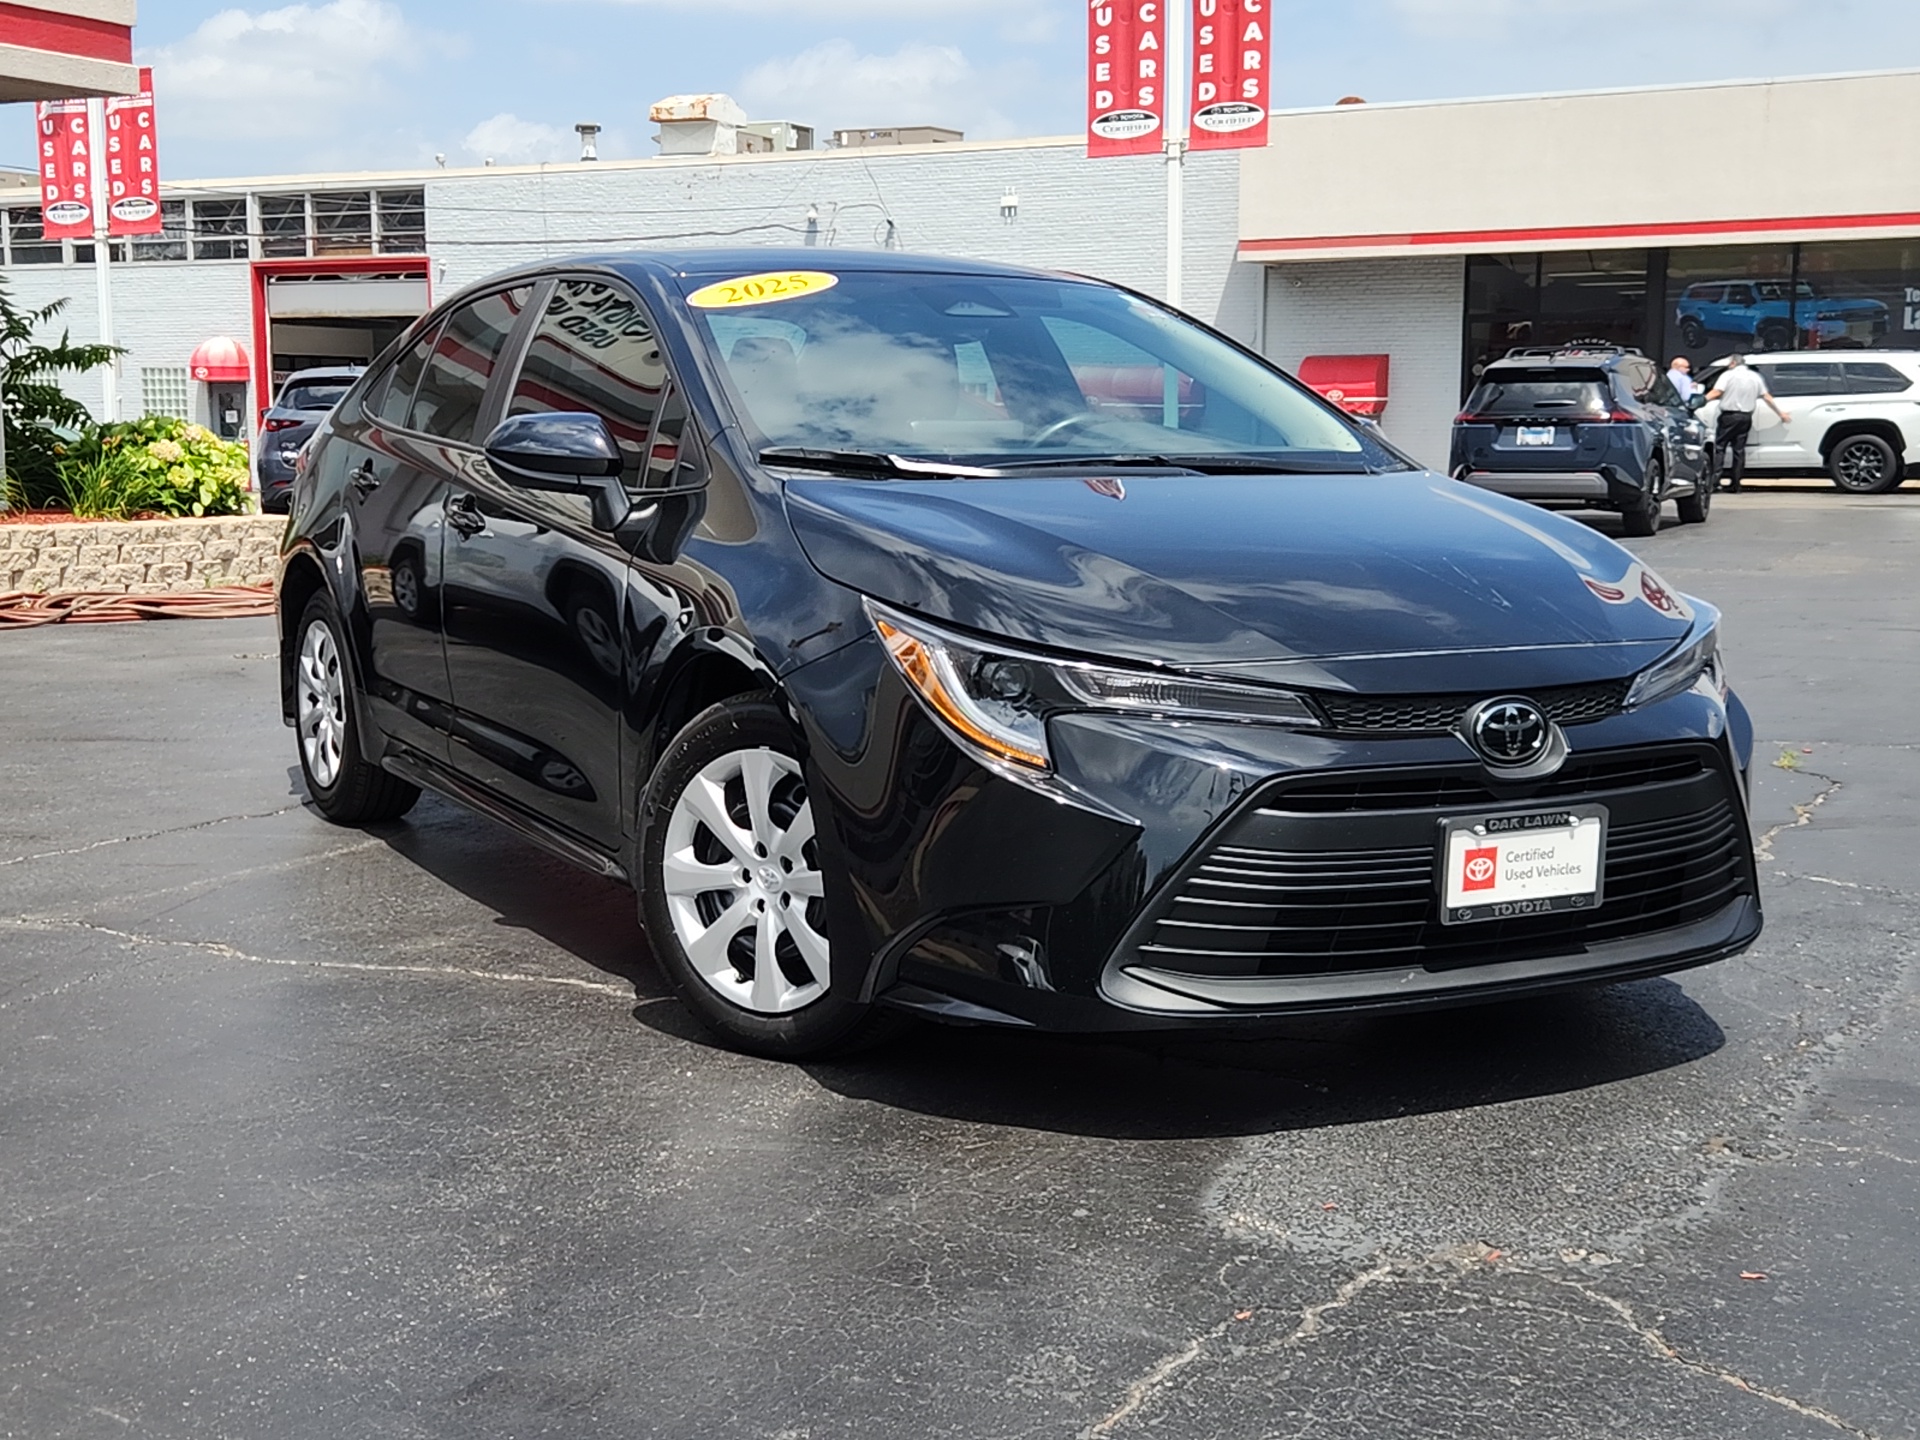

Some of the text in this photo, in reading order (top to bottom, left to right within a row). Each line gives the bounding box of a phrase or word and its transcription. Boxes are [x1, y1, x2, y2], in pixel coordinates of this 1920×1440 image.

[1095, 7, 1114, 109] USED
[1138, 3, 1158, 106] CARS
[1198, 0, 1216, 101] USED
[1242, 0, 1263, 98] CARS
[42, 119, 58, 200] USED
[70, 118, 87, 199] CARS
[109, 114, 125, 196] USED
[138, 112, 152, 195] CARS
[718, 275, 808, 303] 2025
[1488, 813, 1569, 831] OAK LAWN
[1505, 846, 1555, 863] Certified
[1491, 899, 1552, 917] TOYOTA
[1504, 862, 1582, 881] Used Vehicles
